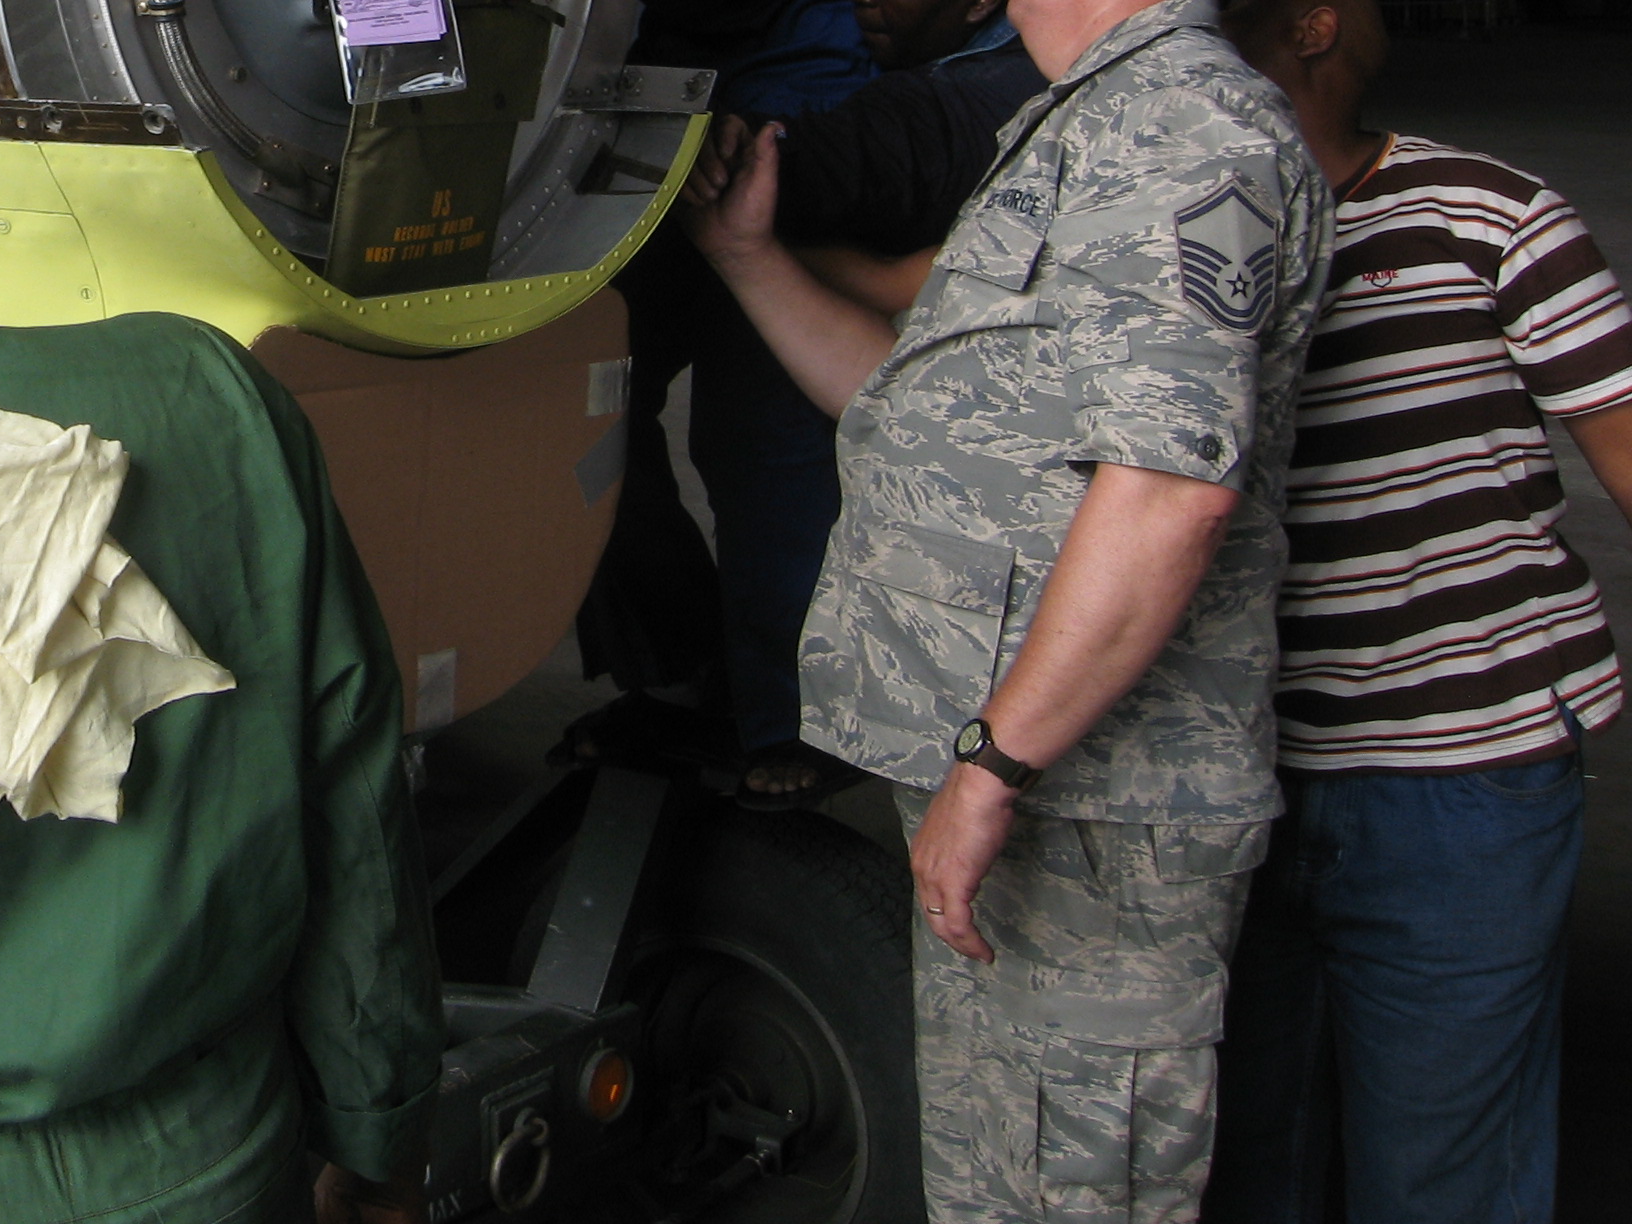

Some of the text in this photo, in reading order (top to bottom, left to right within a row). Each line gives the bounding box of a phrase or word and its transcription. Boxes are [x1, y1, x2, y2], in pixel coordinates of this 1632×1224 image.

[431, 188, 452, 218] US
[365, 247, 397, 263] MUST
[401, 242, 427, 261] STAY
[431, 238, 455, 256] WITH
